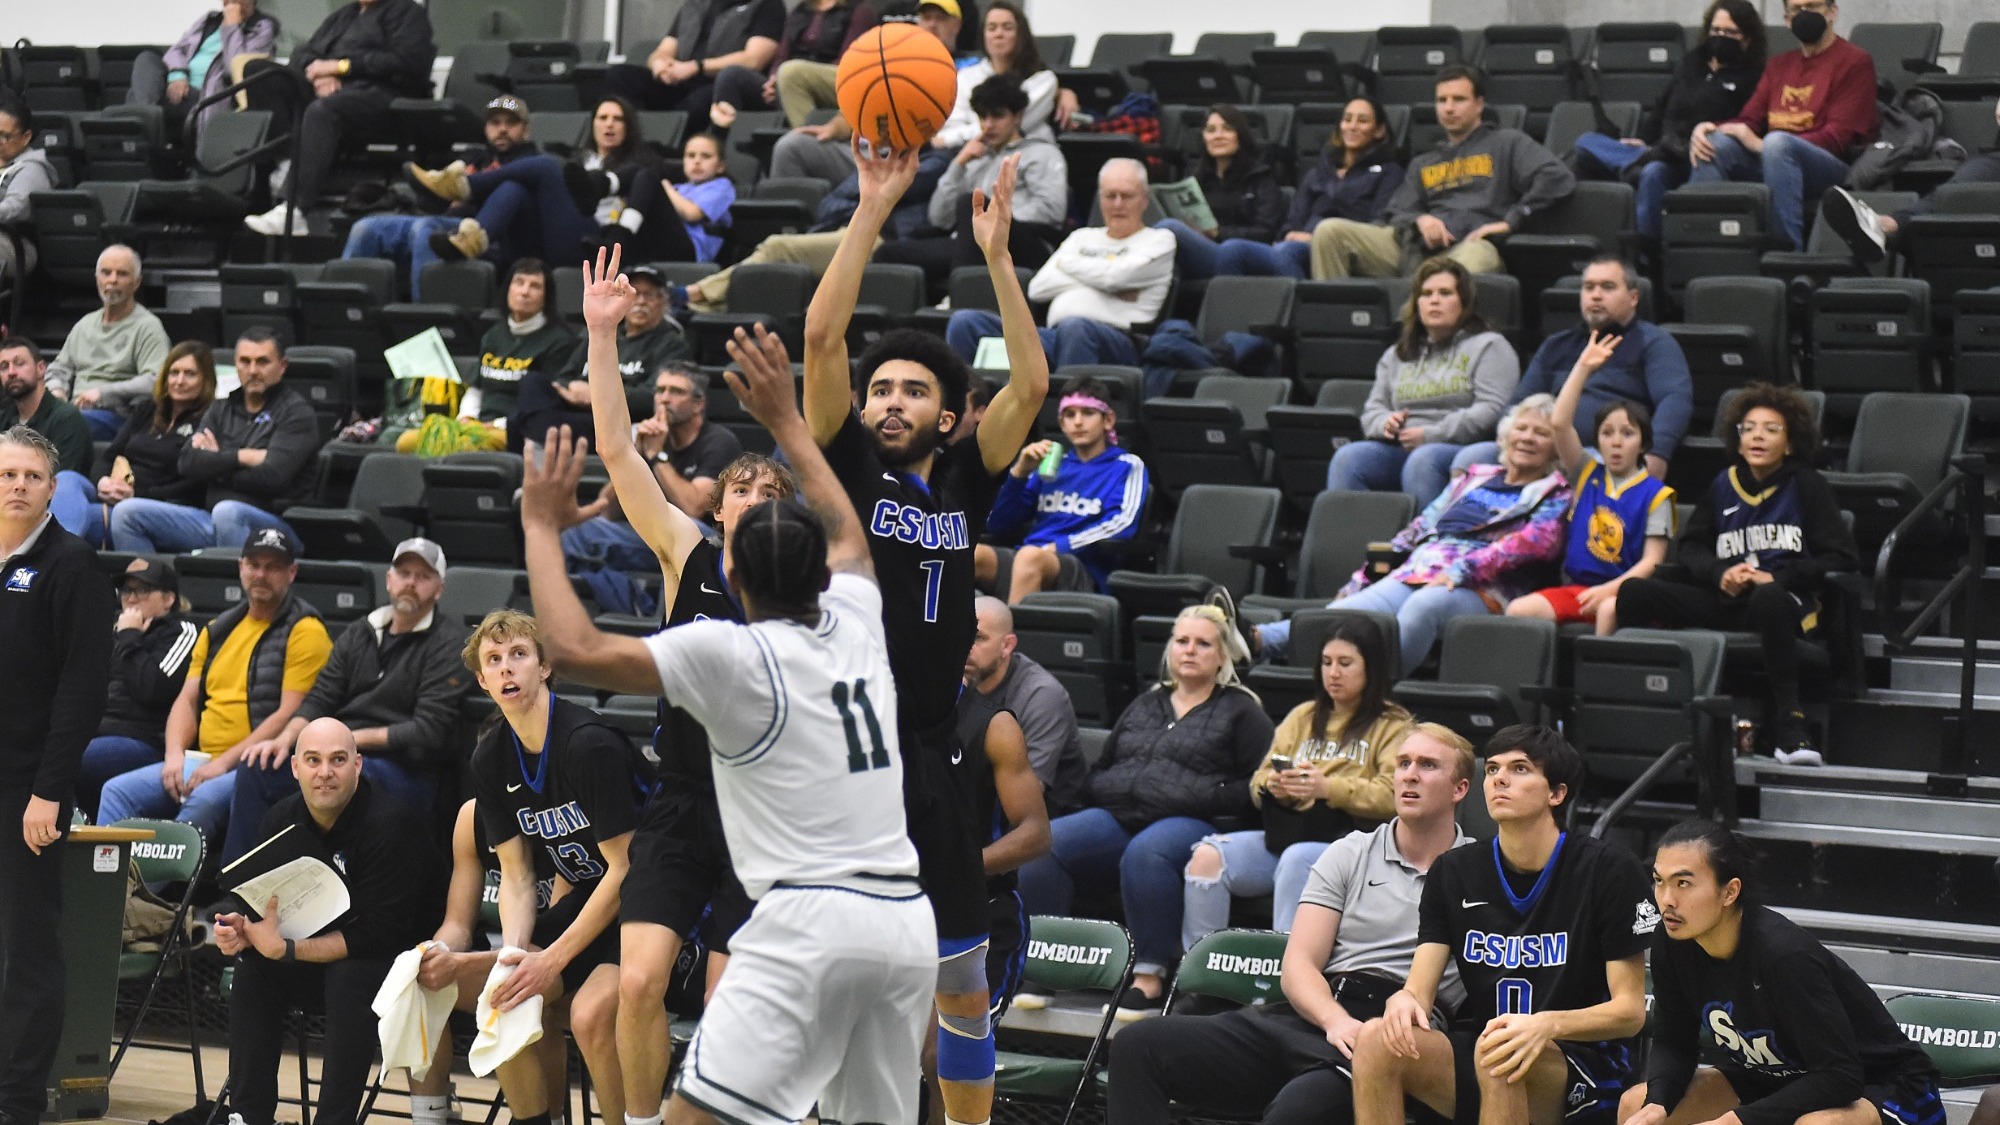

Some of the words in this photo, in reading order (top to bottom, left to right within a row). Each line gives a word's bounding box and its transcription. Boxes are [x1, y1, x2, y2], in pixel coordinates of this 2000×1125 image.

[870, 498, 969, 550] CSUSM
[1745, 523, 1802, 552] ORLEANS
[11, 567, 35, 586] SM
[920, 559, 945, 623] 1
[831, 677, 891, 774] 11
[1463, 929, 1568, 968] CSUSM
[1709, 1009, 1784, 1066] SM
[1896, 1023, 2000, 1048] UMBOLD
